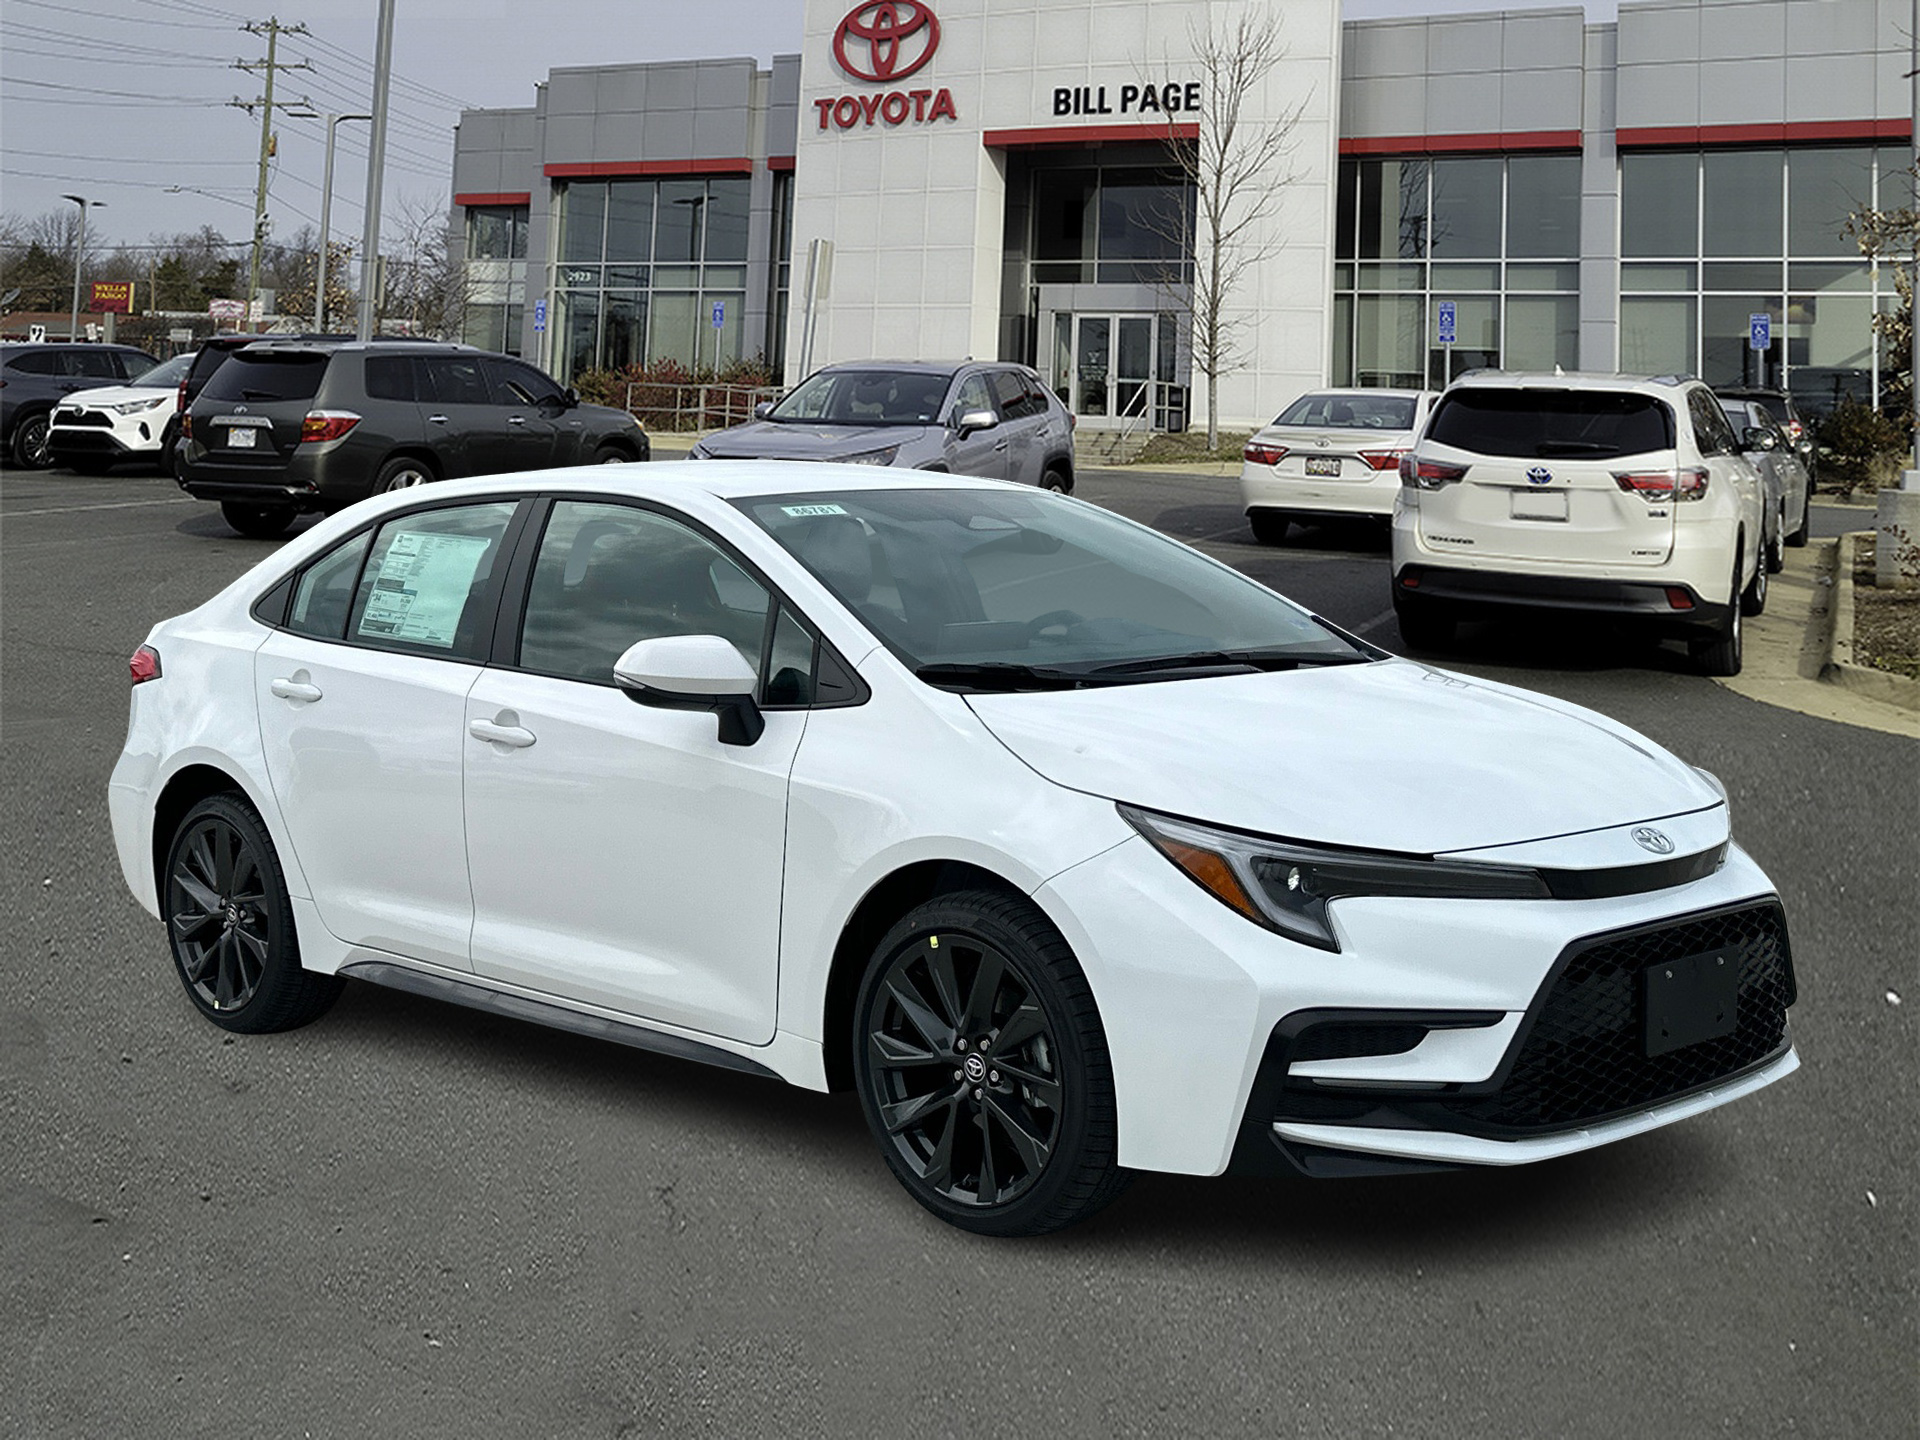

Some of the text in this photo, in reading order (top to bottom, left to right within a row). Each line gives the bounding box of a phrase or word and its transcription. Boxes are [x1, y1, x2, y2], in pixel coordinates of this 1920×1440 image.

[814, 88, 957, 130] TOYOTA
[1053, 82, 1201, 116] BILL PAGE
